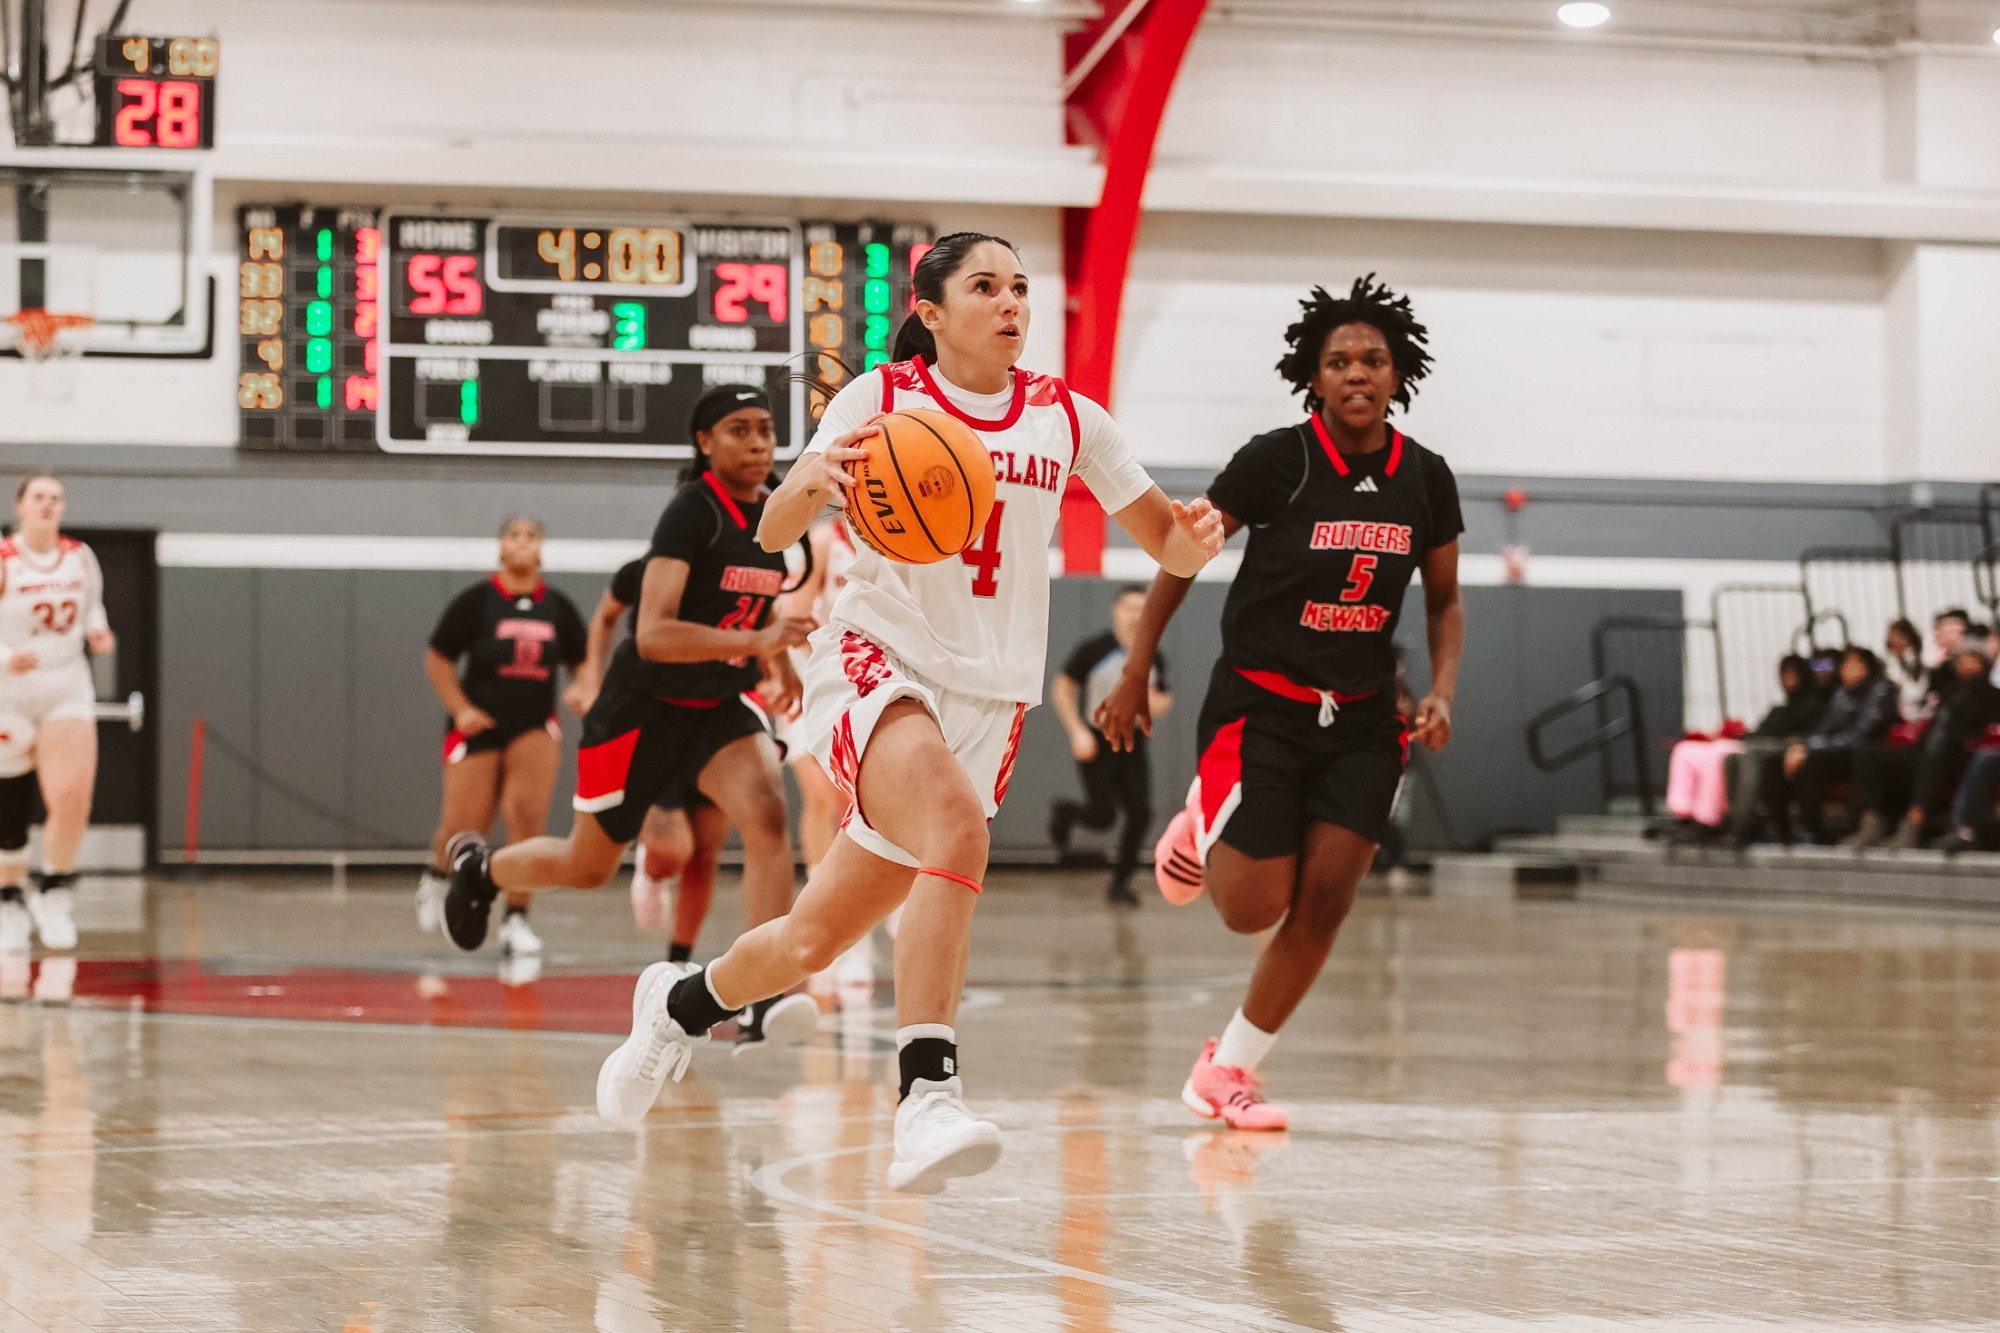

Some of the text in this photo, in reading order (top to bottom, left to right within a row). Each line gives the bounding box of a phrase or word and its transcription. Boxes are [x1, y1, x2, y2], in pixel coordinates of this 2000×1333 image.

[122, 38, 219, 76] 4:00
[115, 79, 199, 148] 28
[537, 227, 681, 285] 4:00
[408, 254, 483, 315] 55
[714, 262, 788, 323] 29
[612, 302, 645, 351] 3
[990, 450, 1061, 493] CLAIR
[865, 479, 906, 534] EVO
[959, 500, 1007, 599] 4
[1309, 520, 1412, 555] RUTGERS
[1339, 554, 1378, 602] 5
